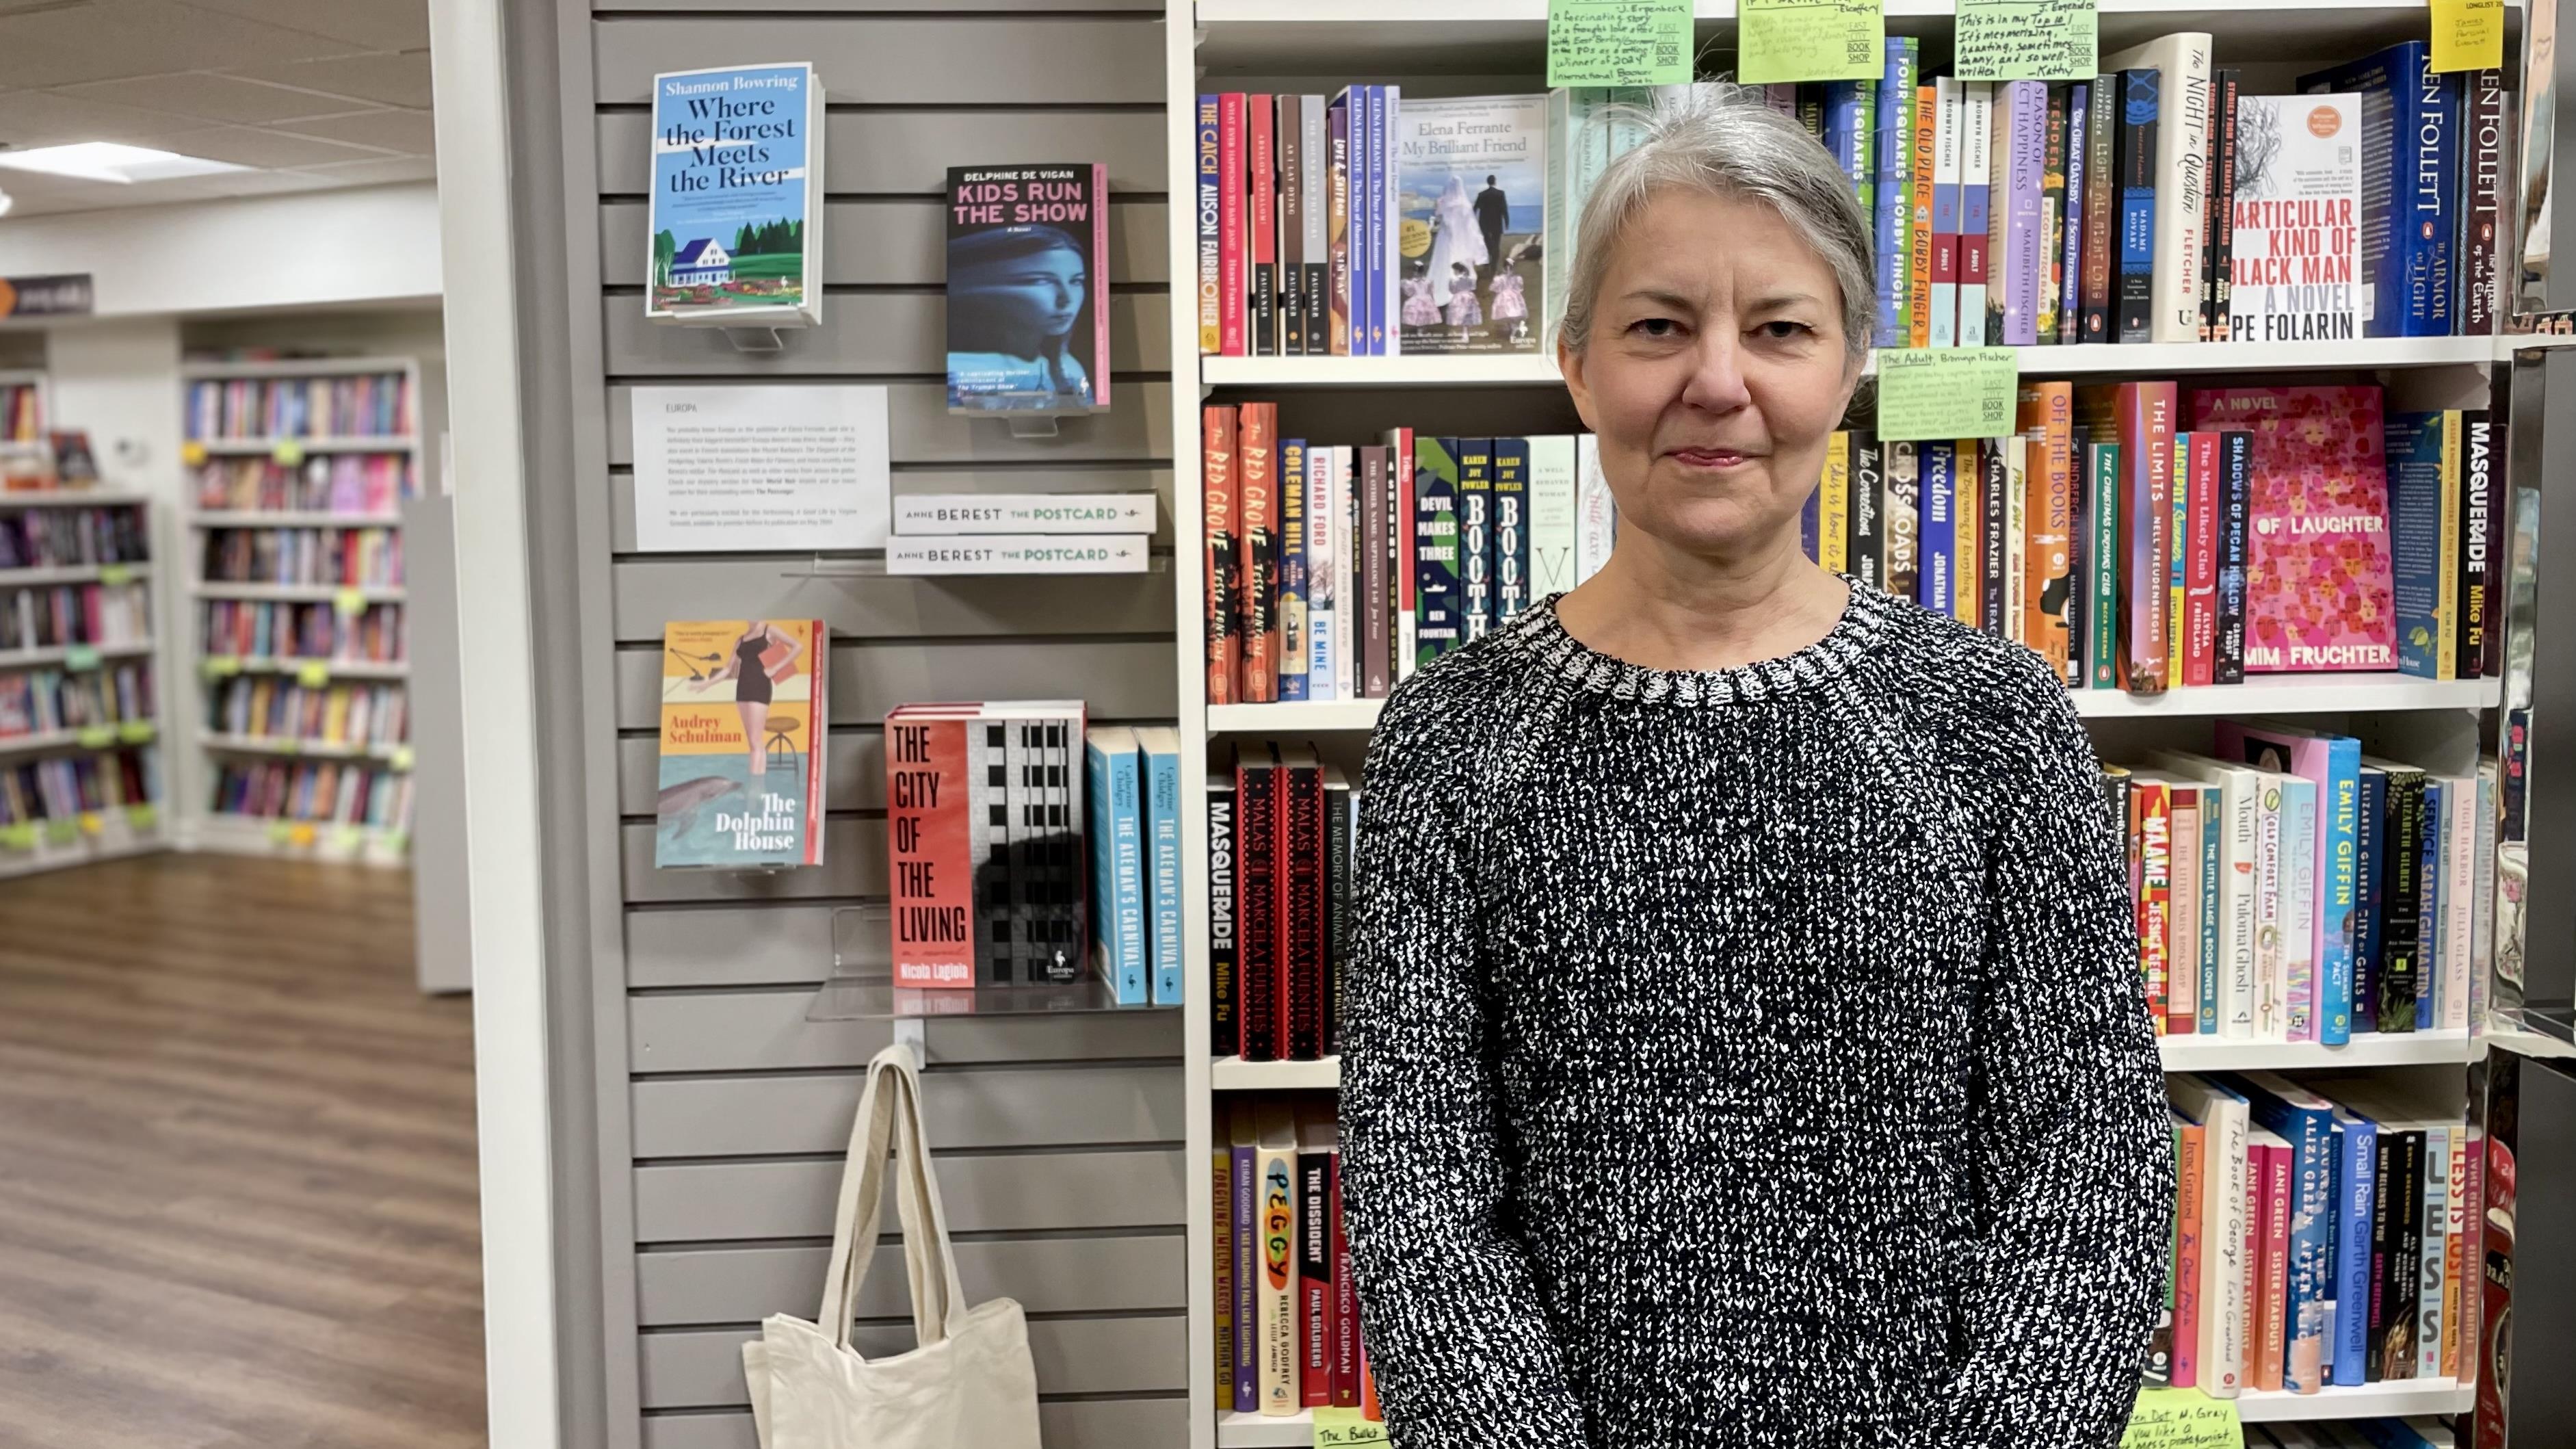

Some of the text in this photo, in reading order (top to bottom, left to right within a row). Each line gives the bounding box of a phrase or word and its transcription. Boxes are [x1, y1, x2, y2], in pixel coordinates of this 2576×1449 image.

[1656, 45, 1679, 54] BOOK
[1657, 57, 1679, 65] SHOP
[1848, 43, 1870, 51] BOOK
[1848, 53, 1870, 62] SHOP
[2069, 57, 2091, 66] SHOP
[666, 76, 799, 96] Shannon Bowring
[687, 96, 775, 120] Where
[1895, 57, 1909, 179] FOUR SQUARES
[2033, 87, 2044, 166] SEASON OF
[667, 119, 796, 146] the Forest
[1419, 121, 1512, 136] Elena Ferrante
[2049, 99, 2062, 166] TENDER
[689, 144, 770, 168] Meets
[1404, 137, 1527, 158] My Brilliant Friend
[1916, 101, 1934, 199] THE OLD PLACE
[2016, 112, 2029, 191] HAPPINESS
[2476, 114, 2500, 212] FOLLETT
[671, 167, 789, 192] the River
[958, 183, 1081, 203] KIDS RUN
[954, 204, 1087, 224] THE SHOW
[1200, 103, 1218, 326] THE CATCH ALISON FAIRBROTHER
[2129, 212, 2138, 250] BOVARY
[2139, 209, 2147, 252] MADAME
[1893, 196, 1905, 310] BOBBY FINGER
[1941, 248, 1949, 272] ADULT
[2269, 227, 2356, 257] KIND OF
[1913, 229, 1929, 328] BOBBY FINGER
[2182, 229, 2194, 294] FLETCHER
[2231, 256, 2352, 286] BLACK MAN
[2265, 284, 2354, 313] A NOVEL
[1882, 352, 2012, 366] The Adult, Bronwyn Fischer
[666, 404, 697, 413] EUROPA
[1983, 402, 2003, 410] BOOK
[1984, 412, 2003, 420] SHOP
[1463, 456, 1487, 465] KAREN
[1497, 457, 1521, 467] KAREN
[2051, 395, 2067, 530] OFF THE BOOKS
[2151, 400, 2165, 501] THE LIMITS
[1285, 446, 1302, 556] COLEMAN HILL
[1313, 458, 1326, 547] RICHARD FORD
[1421, 497, 1453, 511] DEVIL
[1461, 481, 1489, 490] FOWLER
[938, 509, 1003, 521] BEREST
[1034, 509, 1117, 519] POSTCARD
[1894, 441, 1912, 573] CROSSROADS
[1990, 456, 2000, 579] CHARLES FRAZIER
[2257, 516, 2384, 534] OF LAUGHTER
[1418, 521, 1456, 536] MAKES
[2468, 422, 2490, 645] MASQUERADE Mike Fu
[1419, 547, 1454, 560] THREE
[1467, 495, 1488, 643] BOOTH
[1934, 552, 1947, 609] JONATHAN
[1419, 628, 1456, 638] FOUNTAIN
[1429, 611, 1445, 621] BEN
[1314, 621, 1326, 670] BE MINE
[2244, 644, 2391, 666] MIM FRUCHTER
[670, 715, 721, 733] Audrey
[670, 729, 741, 744] Schulman
[893, 726, 930, 763] THE
[761, 792, 796, 813] The
[895, 772, 940, 809] CITY
[715, 813, 794, 836] Dolphin
[897, 817, 921, 853] OF
[2238, 796, 2252, 843] Mouth
[735, 833, 794, 850] House
[2144, 816, 2167, 886] MAAME
[2337, 779, 2354, 905] EMILY GIFFIN
[2359, 783, 2371, 902] ELIZABETH GILBERT
[2400, 791, 2413, 893] ELIZABETH GILBERT
[2420, 798, 2436, 912] SERVICE SARAH
[897, 862, 934, 898] THE
[899, 906, 966, 943] LIVING
[1211, 802, 1233, 1021] MASQUERADE Mike Fu
[1252, 798, 1267, 1032] MALAS MARCELA FUENTES
[2147, 903, 2161, 997] JESSICA GEORGE
[2236, 893, 2250, 992] Paloma Ghosh
[2417, 915, 2432, 998] GILMARTIN
[901, 963, 968, 981] Nicola Lagioia
[2303, 1116, 2317, 1226] ALIZA GREEN
[1308, 1168, 1322, 1263] THE DISSIDENT
[2245, 1162, 2258, 1236] JANE GREEN
[2273, 1163, 2285, 1239] JANE GREEN
[1267, 1173, 1289, 1277] PEGGY
[2350, 1135, 2372, 1353] Small Rain Garth Greenwell
[2422, 1151, 2445, 1343] LESS
[2269, 1251, 2282, 1353] SISTER STARDUST
[2371, 1253, 2383, 1329] GARTH GREENWELL
[1279, 1295, 1291, 1385] REBECCA GODFREY
[2196, 1408, 2228, 1421] Gray
[1319, 1426, 1378, 1441] The Bullet
